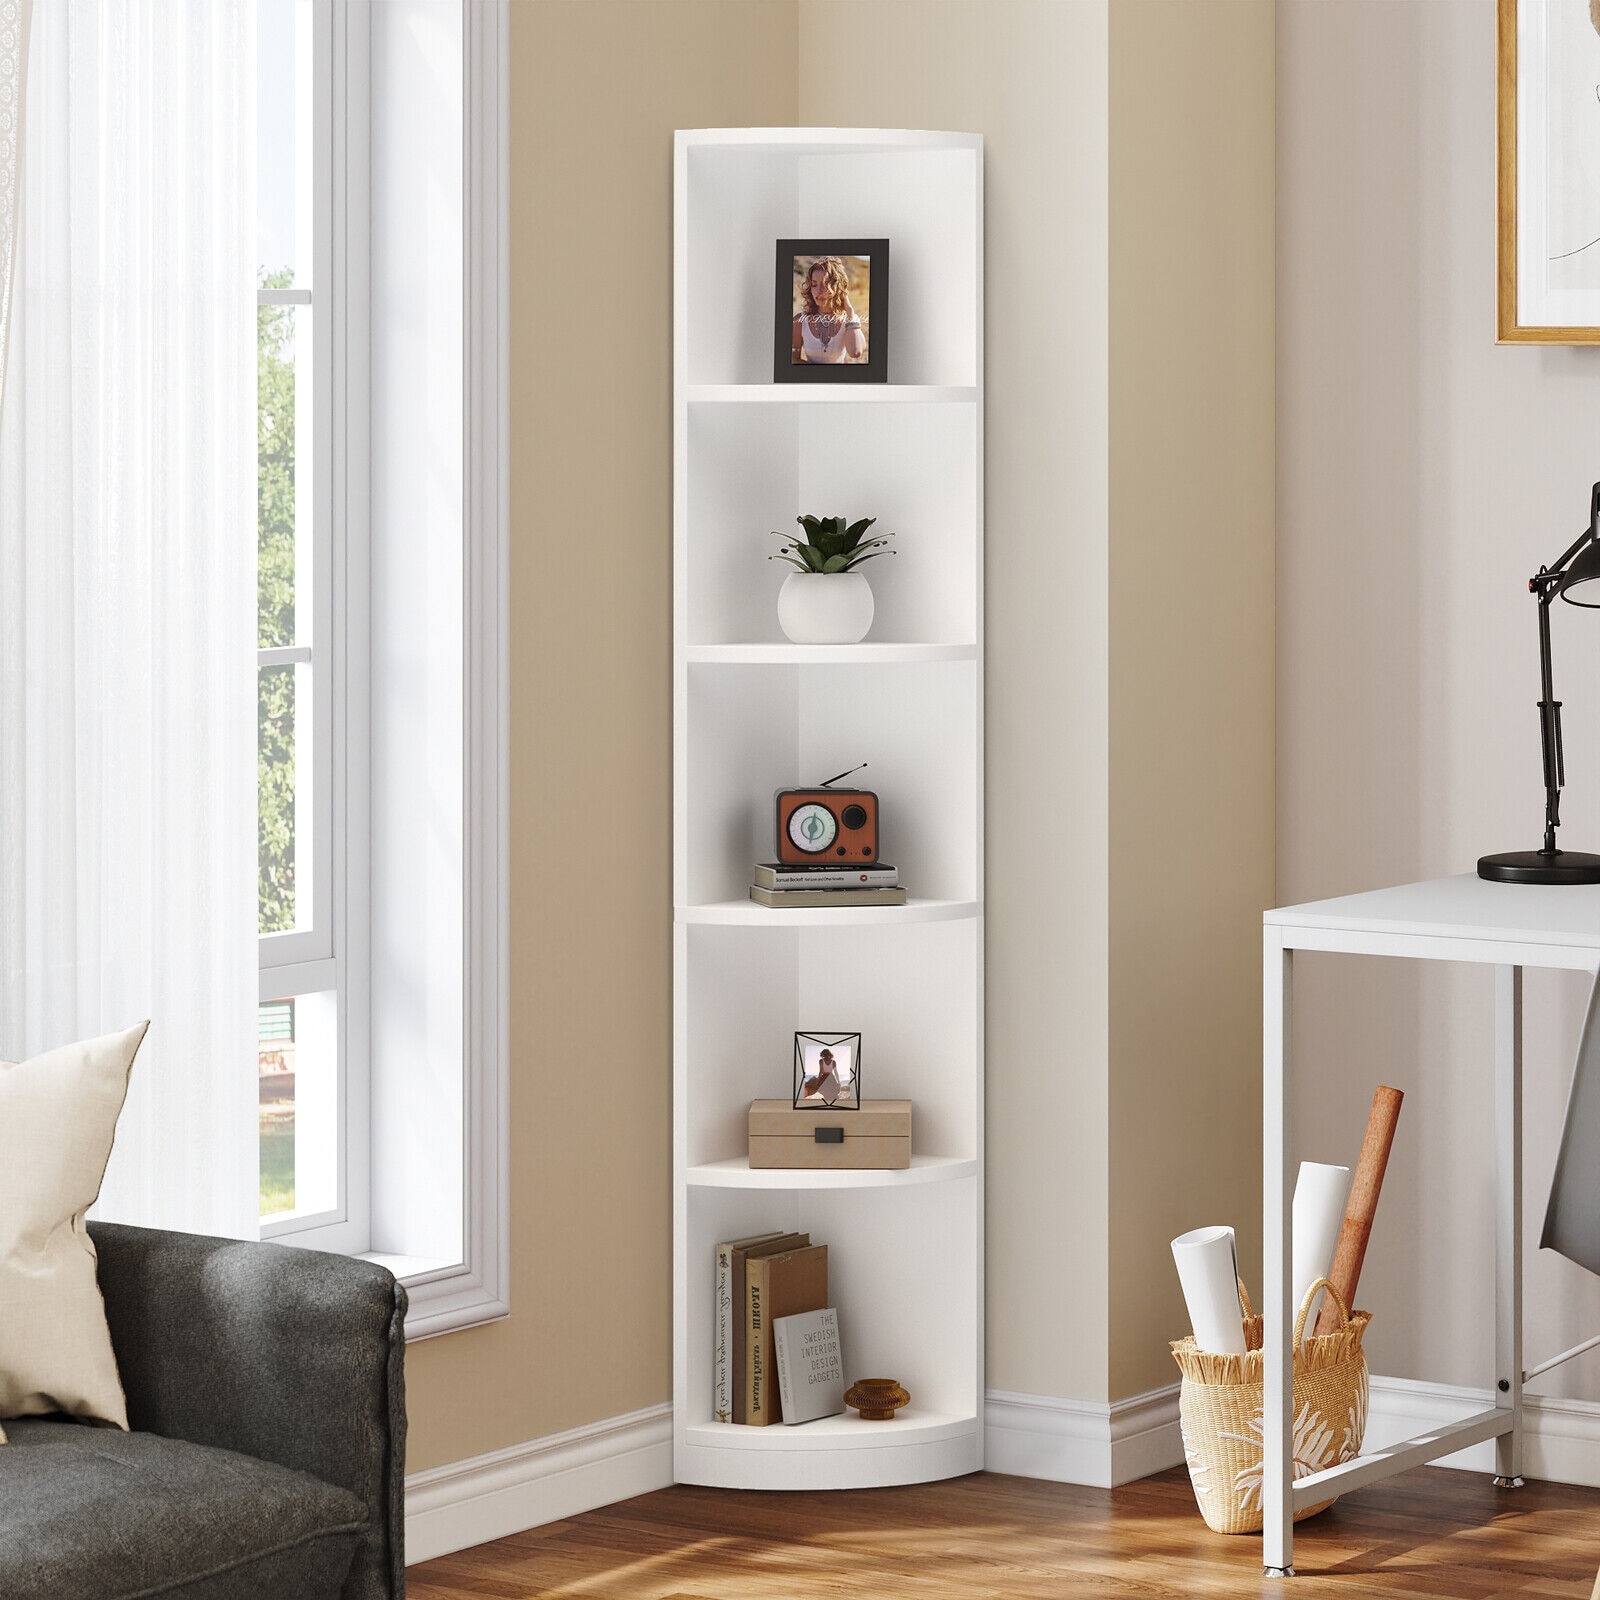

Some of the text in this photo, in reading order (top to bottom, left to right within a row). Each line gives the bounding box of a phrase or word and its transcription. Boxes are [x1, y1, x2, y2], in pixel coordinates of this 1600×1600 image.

[820, 1315, 834, 1326] THE
[804, 1328, 836, 1344] SWEDISH
[801, 1341, 838, 1359] INTERIOR
[811, 1355, 839, 1370] DESIGN
[808, 1369, 840, 1385] GADGETS
